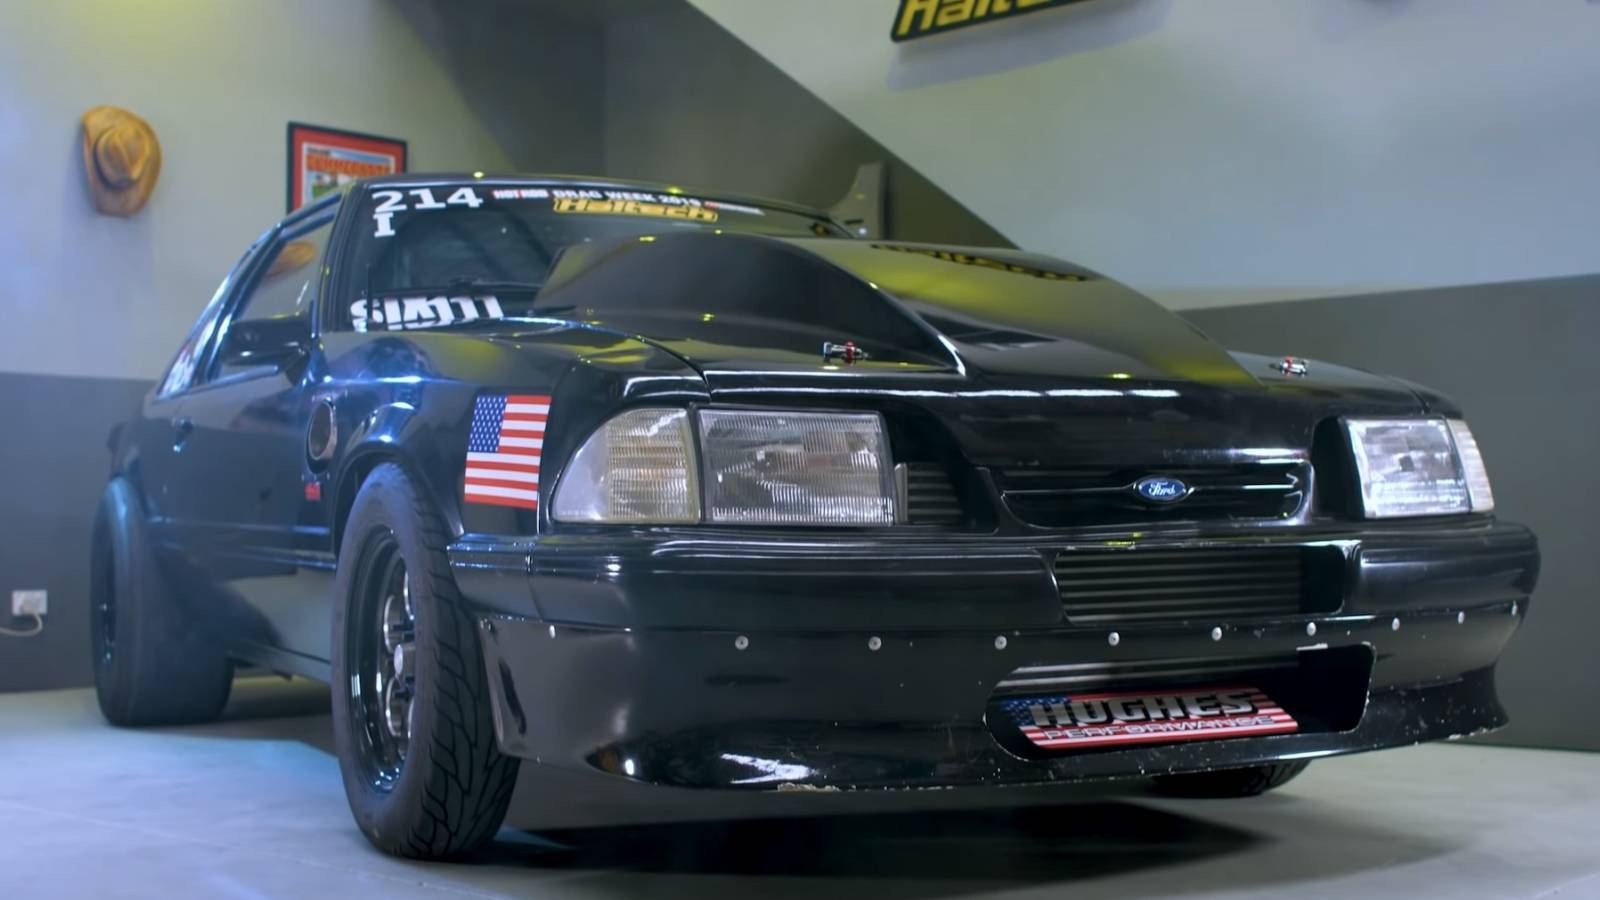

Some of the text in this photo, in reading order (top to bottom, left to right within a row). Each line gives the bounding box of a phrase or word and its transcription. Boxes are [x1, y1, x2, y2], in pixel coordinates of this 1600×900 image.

[371, 186, 484, 213] 214
[552, 189, 602, 201] DRAG
[604, 191, 657, 203] WEEK
[1148, 481, 1176, 496] Ford
[1027, 690, 1258, 727] HUGHES
[1044, 714, 1276, 741] PERFORMANCE
